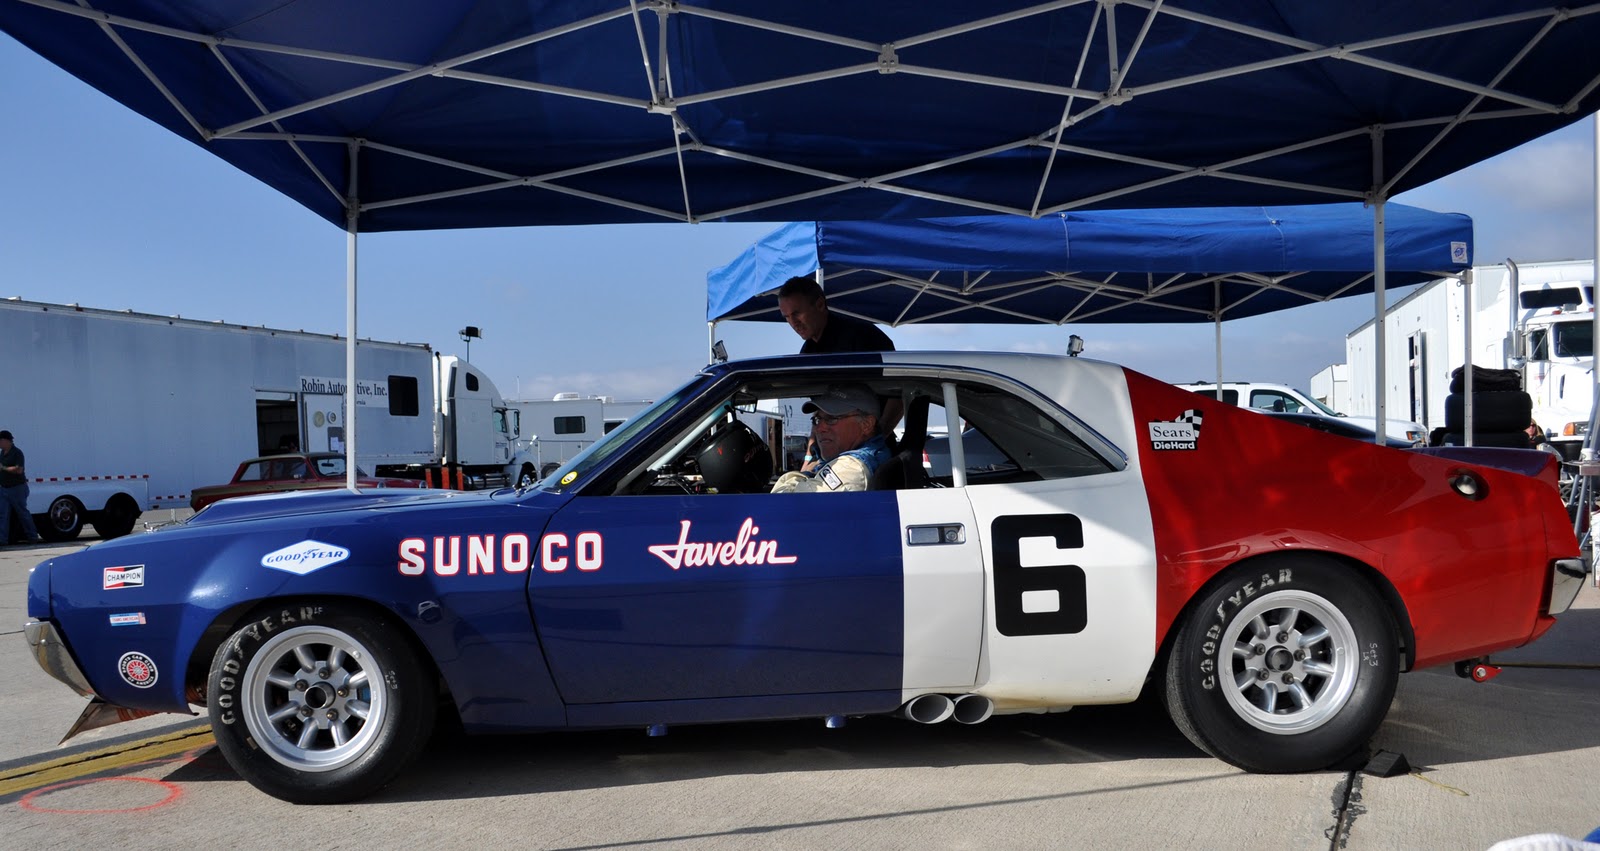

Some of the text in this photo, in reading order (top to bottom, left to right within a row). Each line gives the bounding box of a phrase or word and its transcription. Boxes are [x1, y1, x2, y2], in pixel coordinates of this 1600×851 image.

[301, 378, 388, 396] Robin Autotive, Inc.
[1152, 425, 1192, 438] Sears
[1153, 441, 1196, 450] DieHard
[648, 517, 797, 570] Javelin
[397, 530, 604, 577] SUNOCO
[107, 572, 142, 582] CHAMPION
[991, 513, 1088, 637] 6
